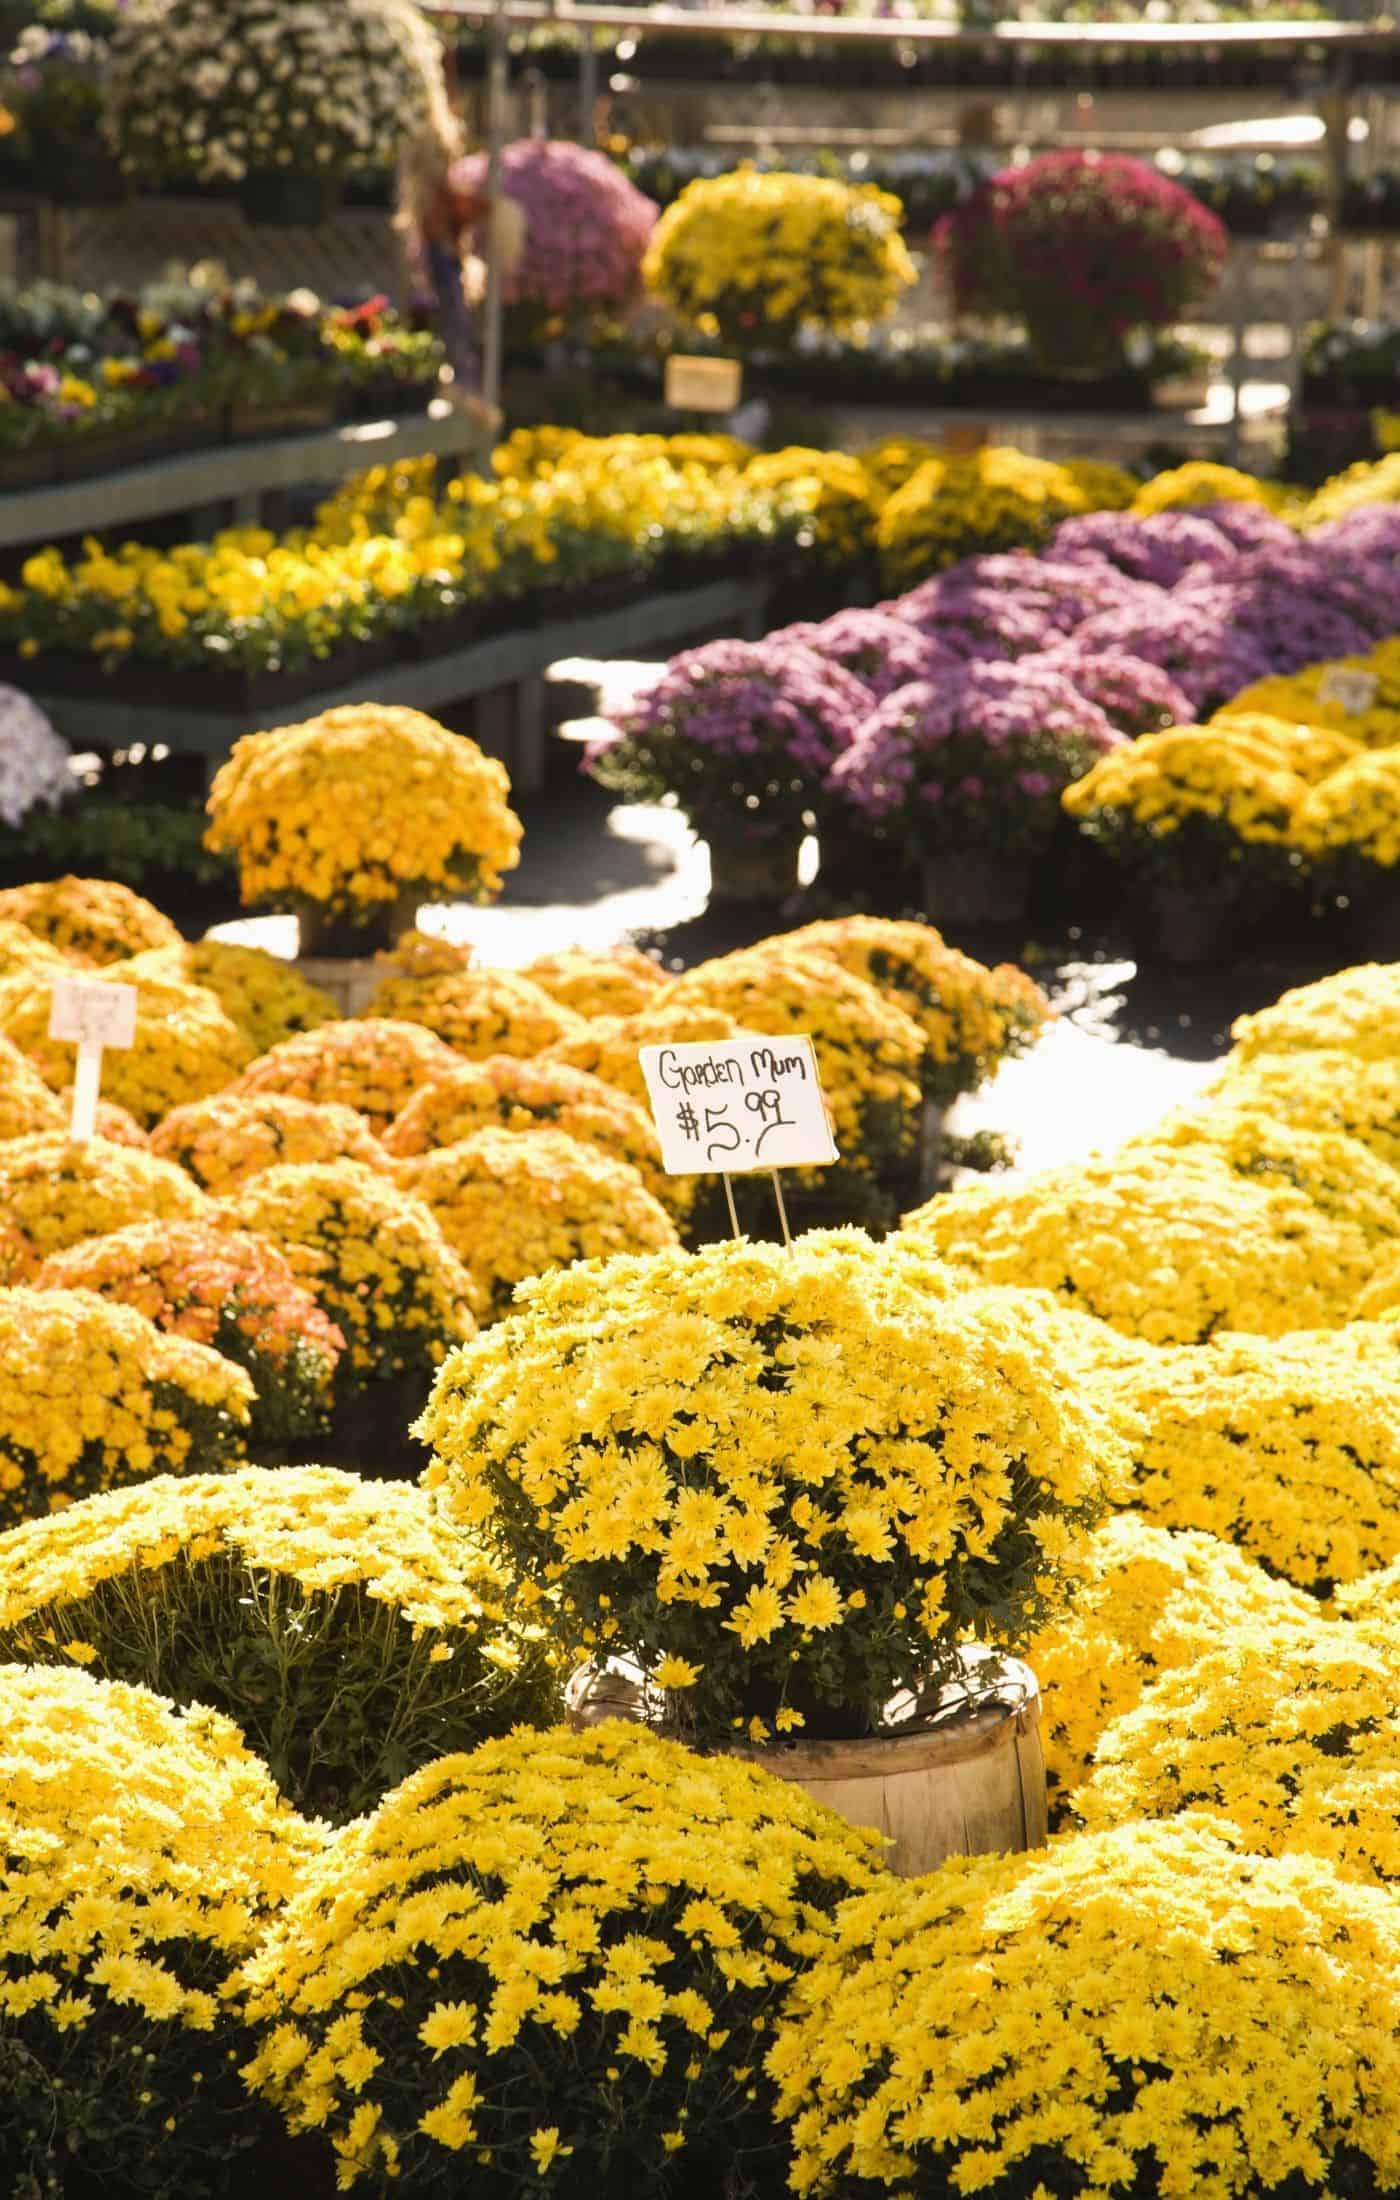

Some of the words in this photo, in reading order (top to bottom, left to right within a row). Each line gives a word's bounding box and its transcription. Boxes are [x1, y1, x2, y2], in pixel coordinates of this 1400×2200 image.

[659, 1050, 744, 1094] Garden
[750, 1048, 806, 1083] Mum
[676, 1089, 796, 1161] $5.99
